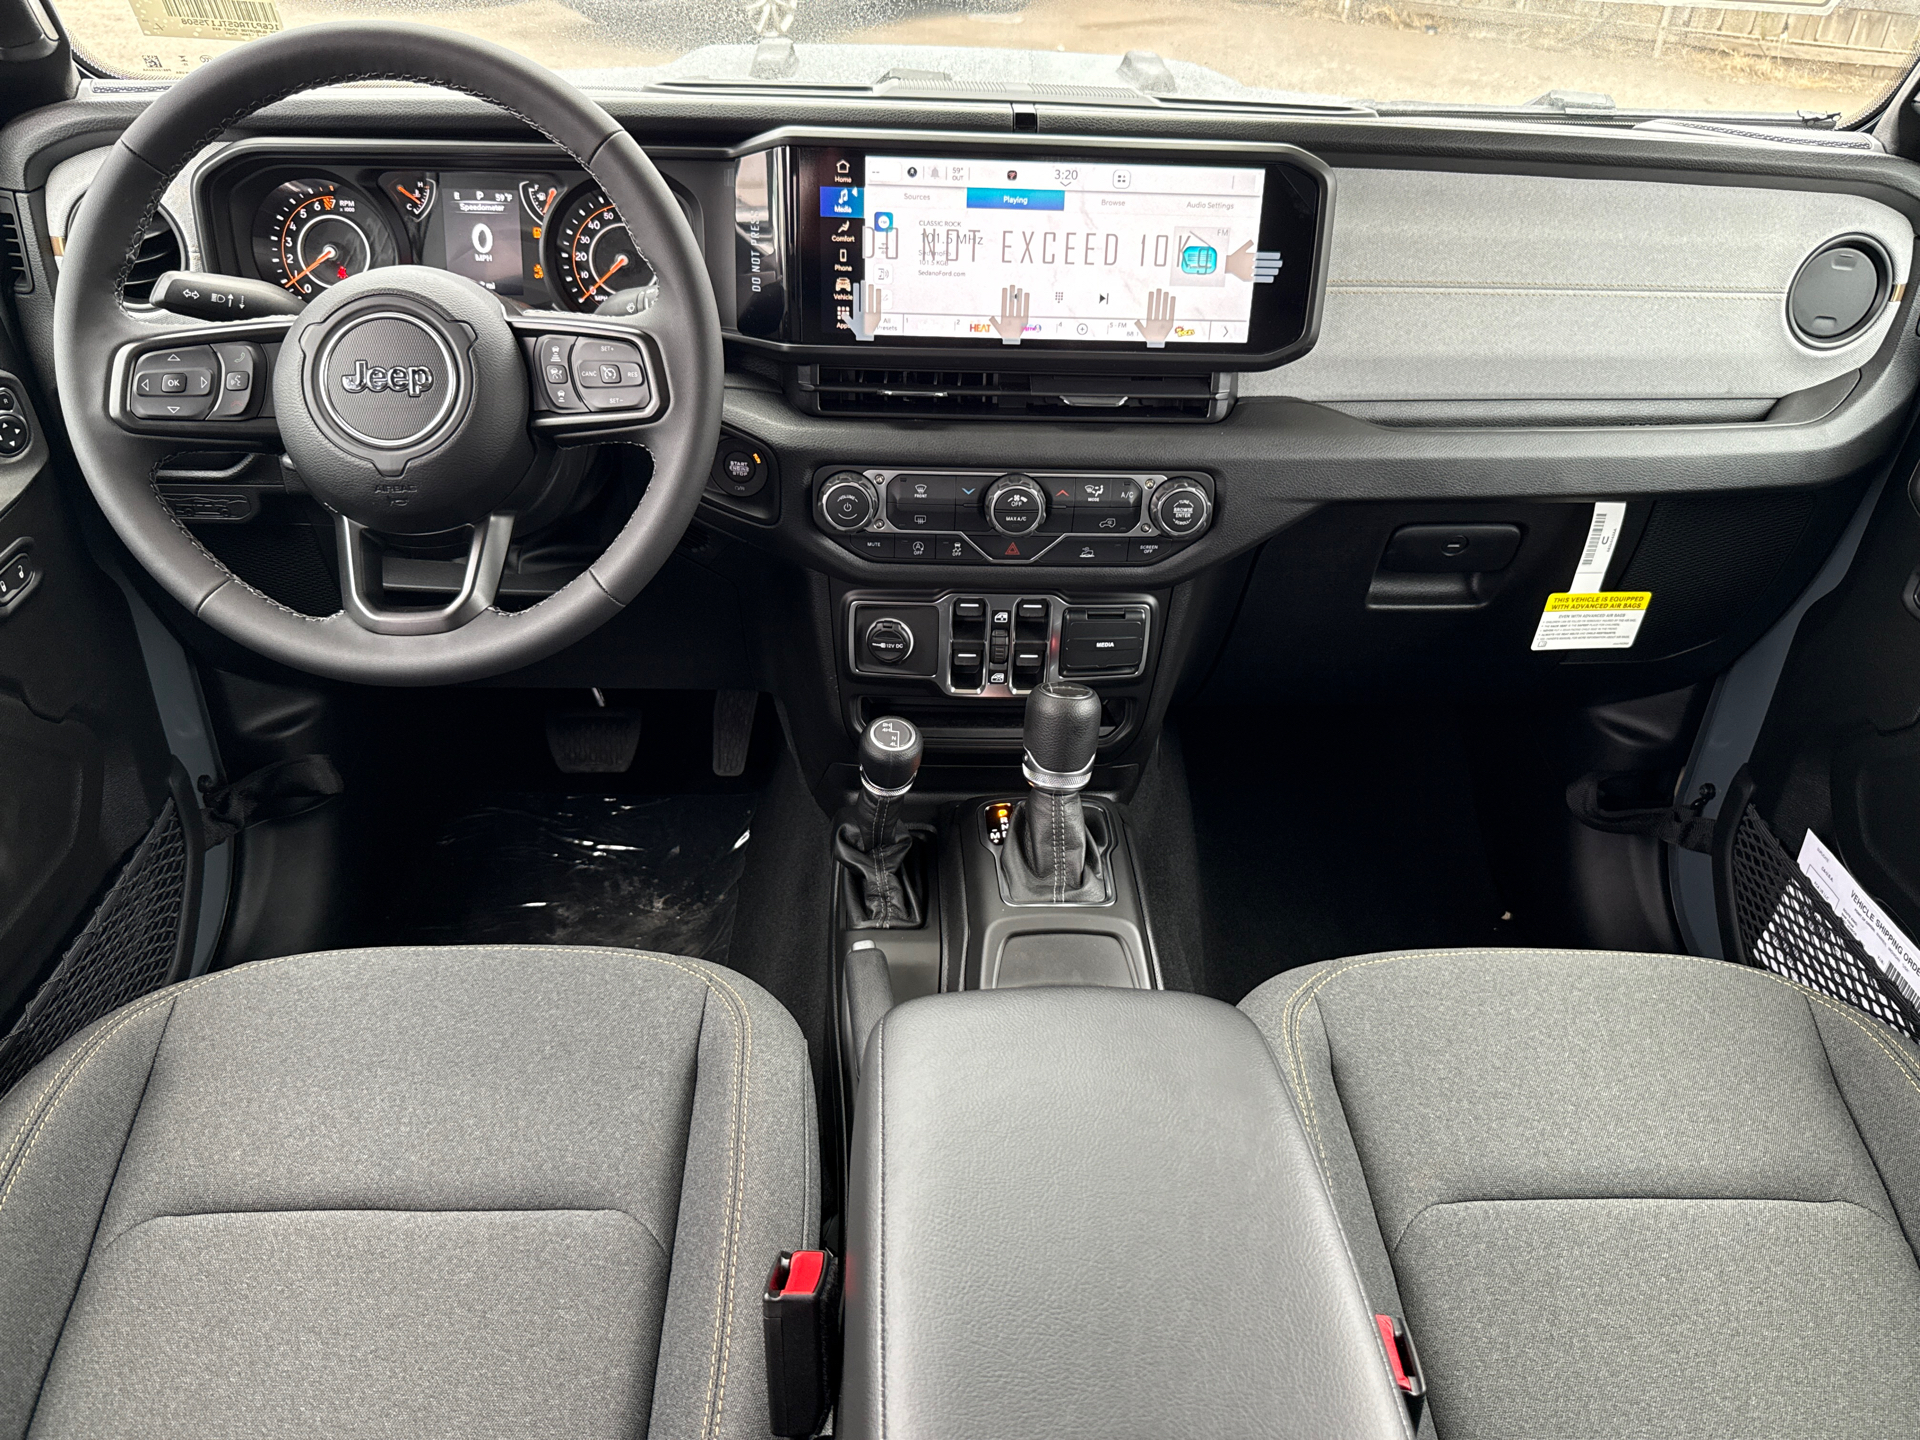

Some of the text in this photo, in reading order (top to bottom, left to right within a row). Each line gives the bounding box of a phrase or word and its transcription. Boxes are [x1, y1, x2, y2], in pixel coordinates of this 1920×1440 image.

[1054, 169, 1078, 180] 3:20
[834, 176, 852, 184] Home
[476, 191, 484, 200] P
[904, 192, 930, 201] Sources
[1003, 195, 1028, 205] Playing
[314, 202, 321, 211] 6
[460, 203, 505, 212] Speedometer
[834, 204, 852, 213] Media
[300, 209, 307, 218] 5
[603, 212, 614, 220] 50
[289, 222, 297, 231] 4
[588, 221, 600, 230] 40
[286, 237, 293, 247] 3
[472, 223, 493, 253] 0
[831, 234, 855, 244] Comfort
[958, 234, 984, 245] MHz
[751, 210, 762, 293] DO NOT PRESS
[922, 228, 980, 262] NOT
[1001, 230, 1118, 266] EXCEED
[287, 254, 294, 264] 2
[474, 254, 493, 262] MPH
[575, 253, 587, 261] 20
[304, 284, 312, 293] 0
[970, 324, 991, 332] HEAT
[342, 359, 434, 398] Jeep
[1850, 890, 1875, 922] VEHICLE
[1876, 919, 1903, 955] SHIPPING
